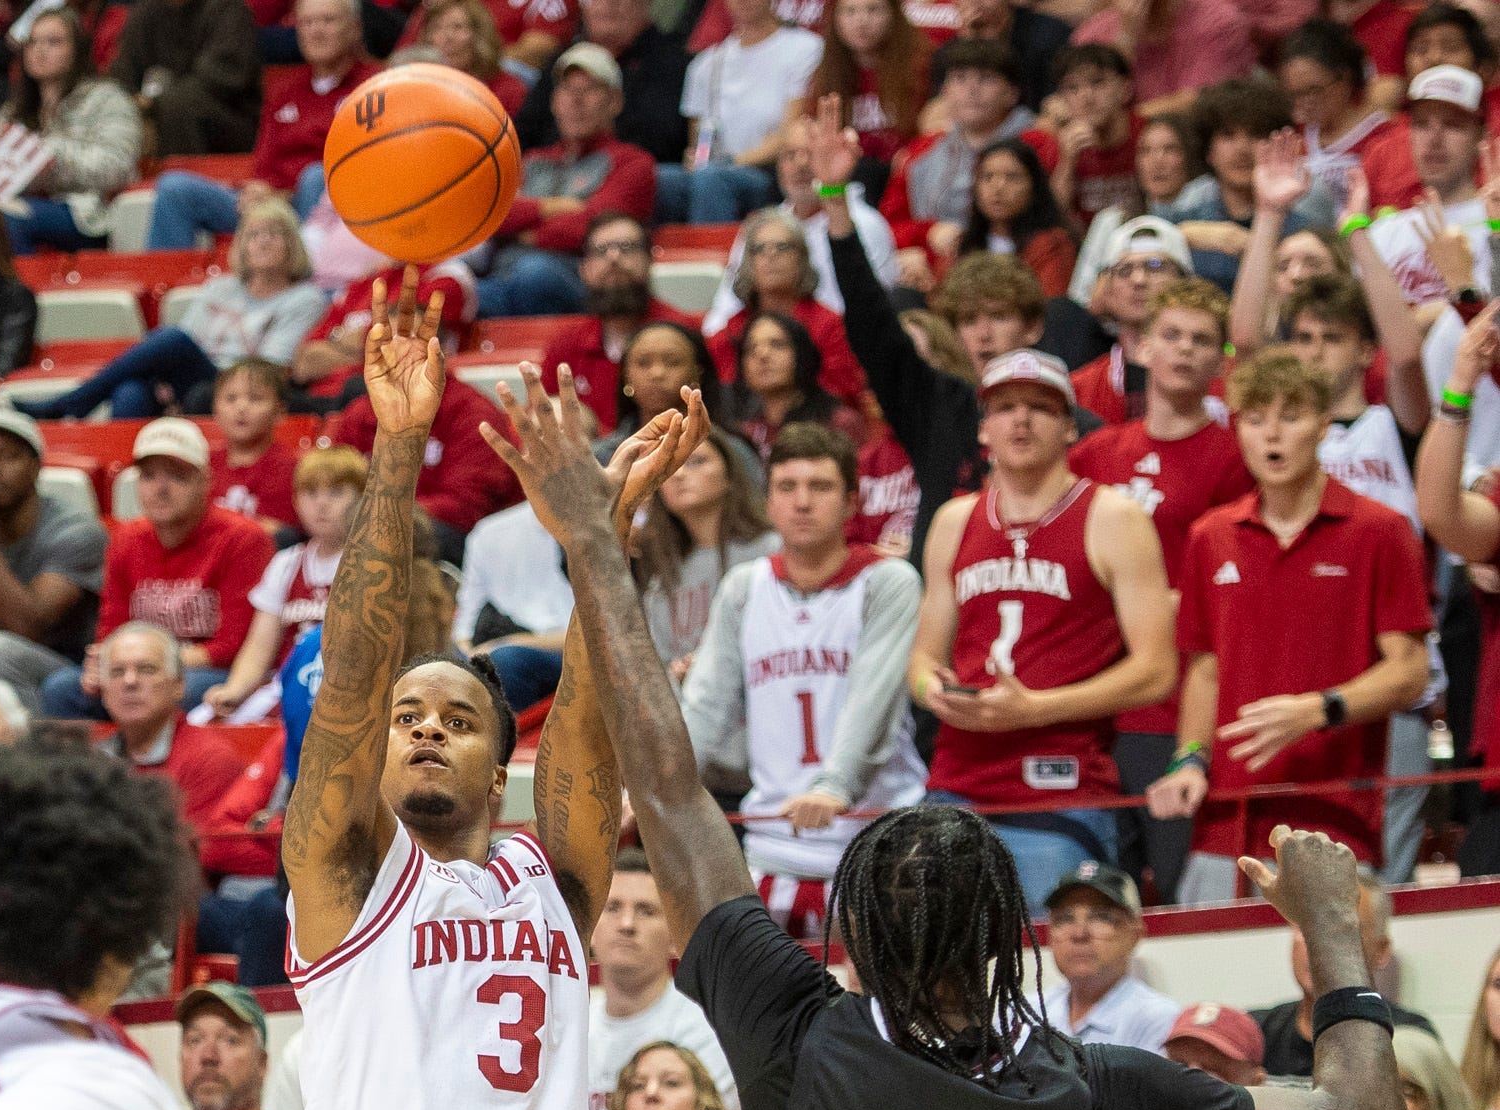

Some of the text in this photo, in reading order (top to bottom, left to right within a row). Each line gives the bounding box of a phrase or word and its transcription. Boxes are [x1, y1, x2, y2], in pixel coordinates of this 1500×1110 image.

[795, 692, 821, 764] 1
[411, 918, 580, 981] INDIAA
[476, 973, 547, 1094] 3
